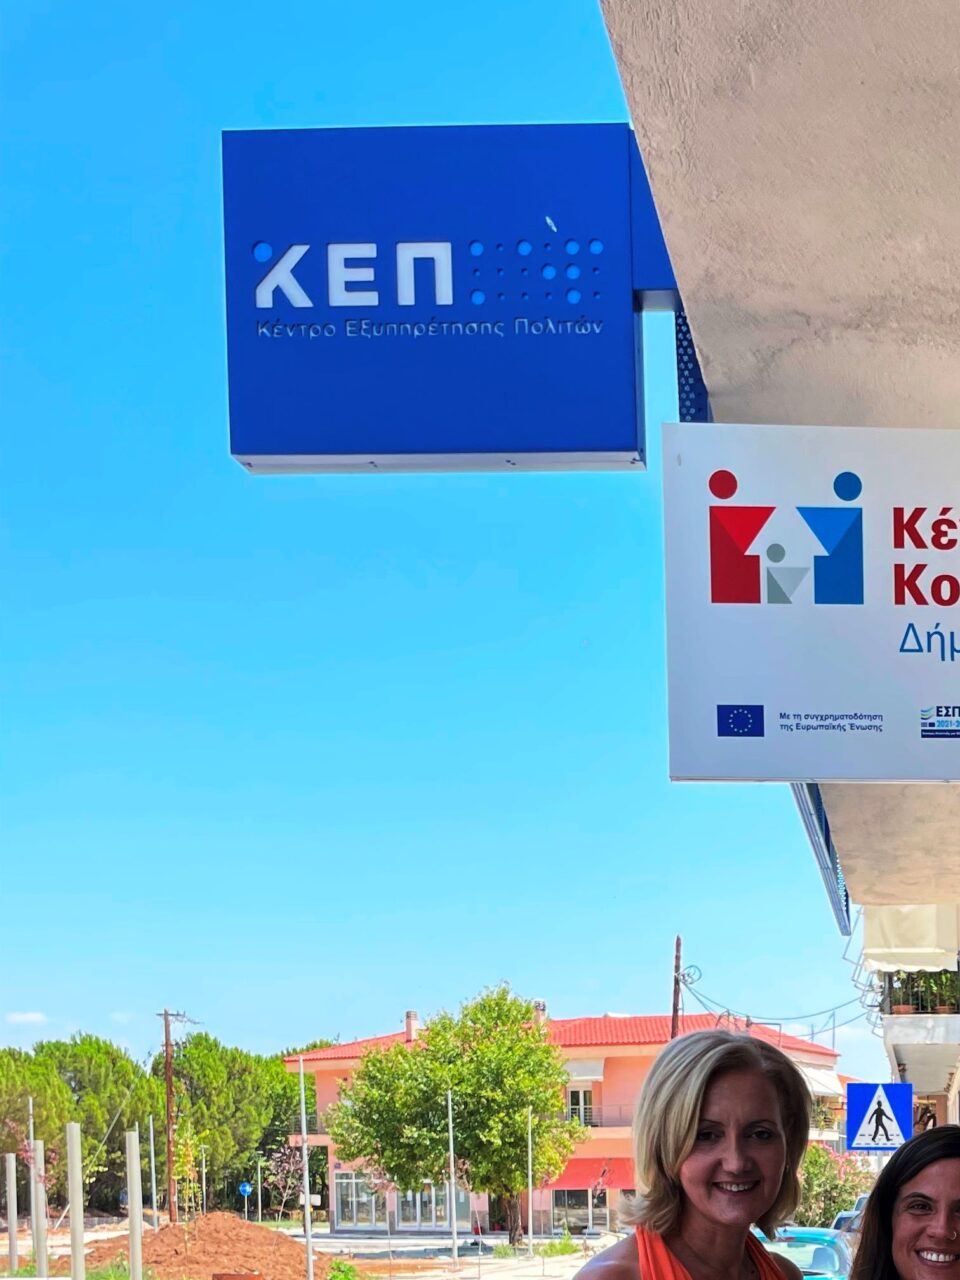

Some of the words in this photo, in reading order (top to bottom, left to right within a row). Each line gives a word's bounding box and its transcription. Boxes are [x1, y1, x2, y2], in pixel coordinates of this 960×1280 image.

[252, 241, 453, 308] ΚΕΠ
[257, 319, 336, 338] Κέντρο
[345, 317, 504, 338] Εξυπηρέτησης
[514, 315, 603, 335] Πολιτών
[779, 712, 790, 720] Με
[793, 713, 802, 721] τη
[803, 712, 883, 722] συγχρηματοδότηση
[779, 724, 793, 732] της
[795, 723, 846, 732] Ευρωπαϊκής
[848, 723, 883, 732] Ένωσης
